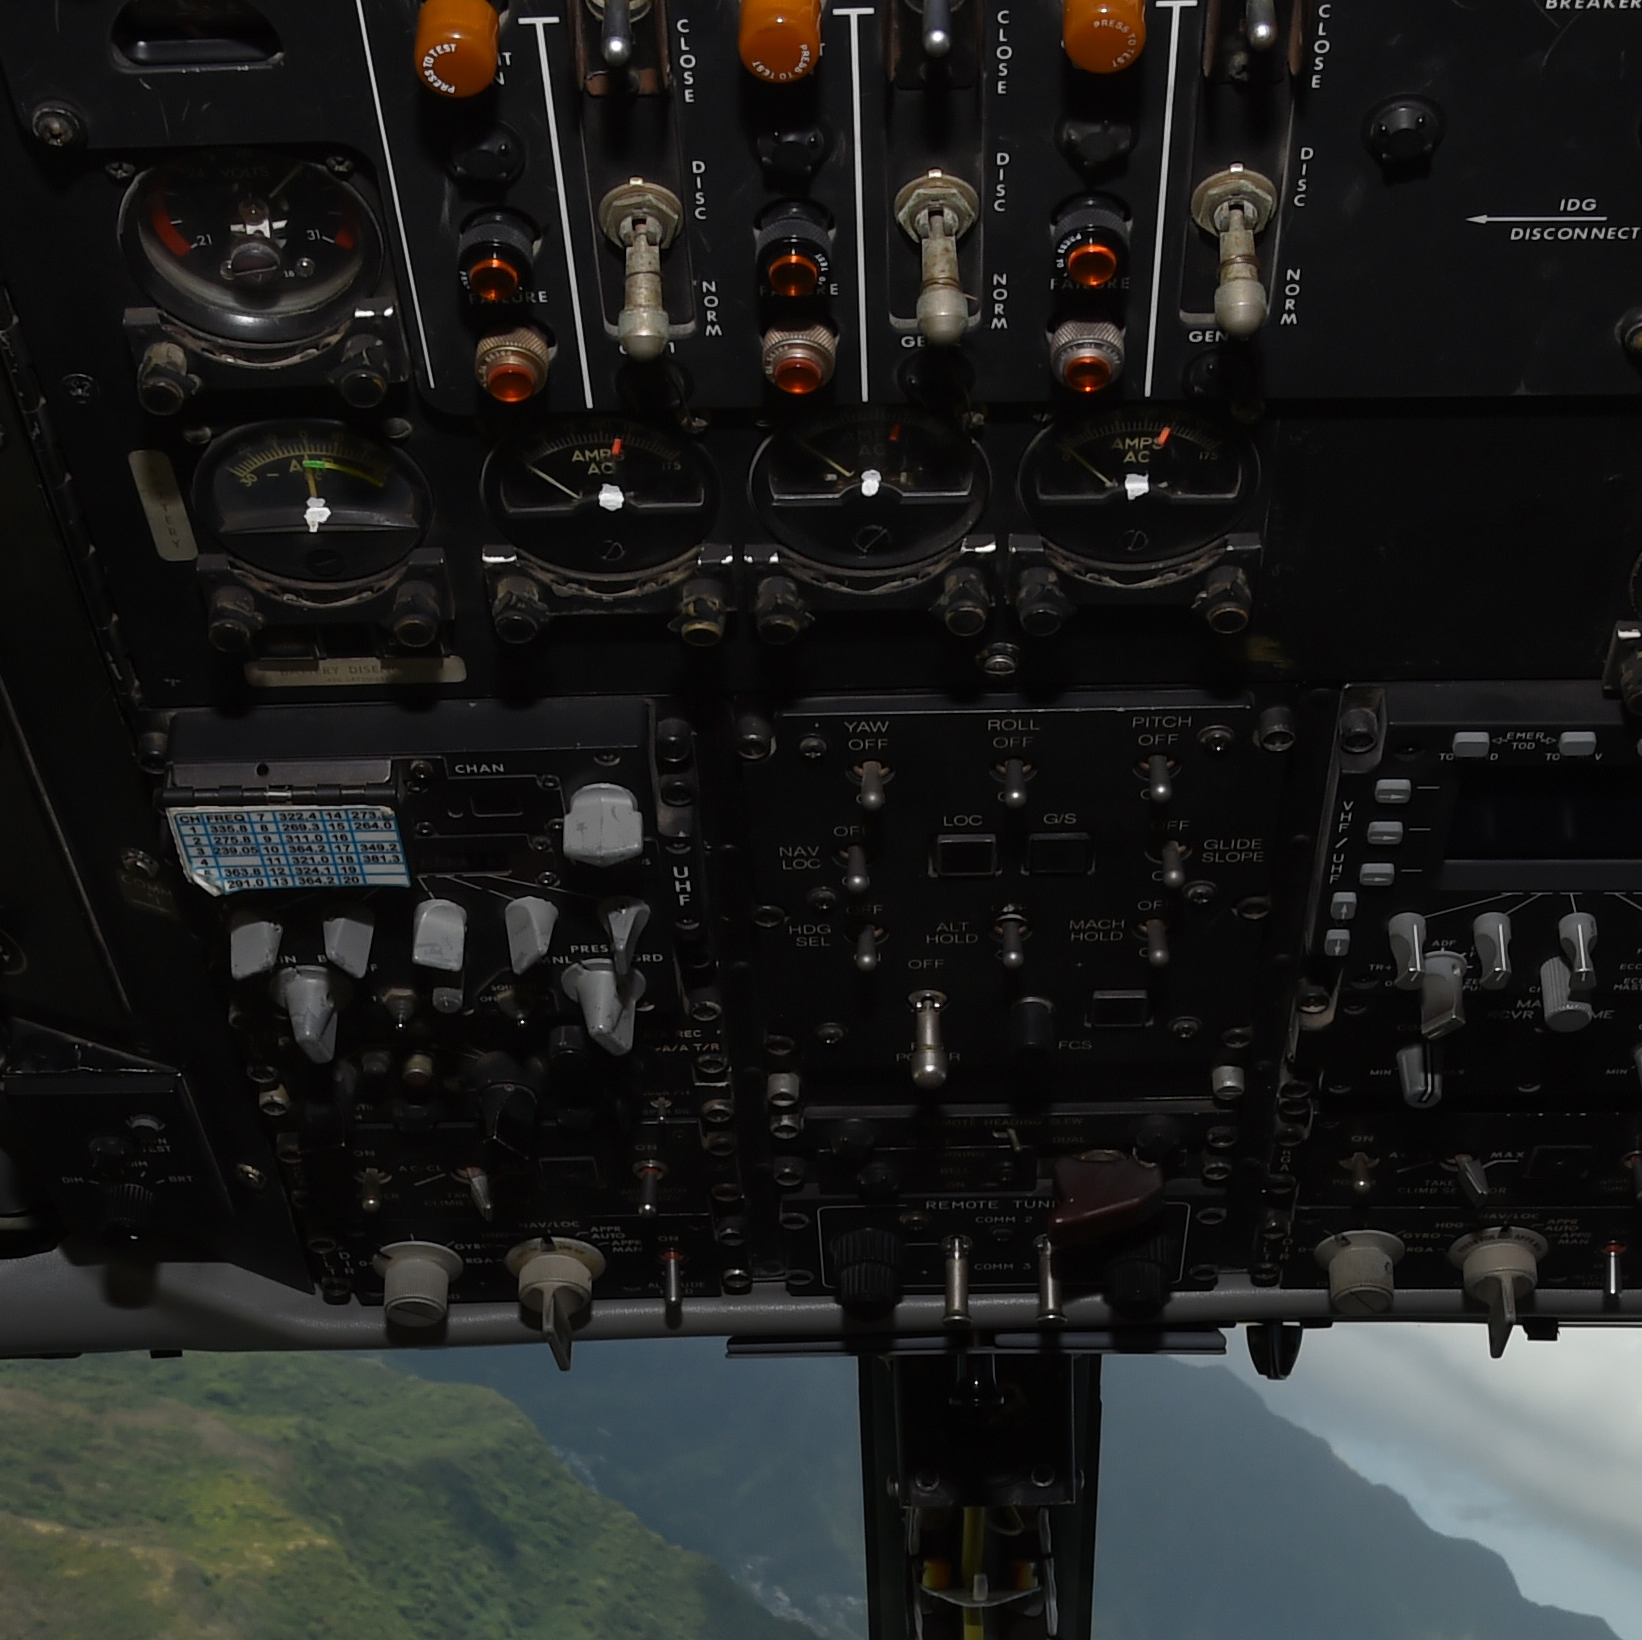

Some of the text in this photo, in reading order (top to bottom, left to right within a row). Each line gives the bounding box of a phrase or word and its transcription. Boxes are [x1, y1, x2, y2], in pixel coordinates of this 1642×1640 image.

[1312, 4, 1331, 88] CLOSE
[997, 10, 1012, 94] CLOSE
[677, 19, 695, 102] CLOSE
[994, 153, 1009, 211] DISC
[1294, 147, 1313, 206] DISC
[692, 161, 706, 219] DISC
[1560, 199, 1596, 211] IDG
[1510, 227, 1640, 240] DISCONNECT
[991, 274, 1007, 329] NORM
[1280, 269, 1300, 324] NORM
[702, 281, 722, 336] NORM
[1189, 331, 1228, 342] GEN
[1113, 437, 1164, 450] AMPS
[1123, 450, 1150, 463] AC
[844, 721, 889, 732] YAW
[988, 719, 1040, 730] ROLL
[1133, 716, 1191, 728] PITCH
[993, 737, 1033, 748] OFF
[1138, 734, 1178, 746] OFF
[1507, 732, 1545, 744] EMER
[848, 738, 888, 750] OFF
[1512, 742, 1535, 750] TOD
[455, 764, 504, 773] CHAN
[179, 813, 245, 823] CH FREQ
[279, 812, 318, 822] 322.4
[944, 815, 982, 826] LOC
[1043, 813, 1076, 824] G/S
[211, 824, 248, 834] 335.8
[282, 823, 319, 832] 269.3
[354, 821, 392, 830] 264.0
[214, 835, 251, 844] 275.8
[285, 833, 322, 842] 311.0
[214, 845, 258, 854] 239.05
[289, 844, 326, 853] 364.2
[359, 843, 396, 852] 349.2
[1204, 839, 1262, 850] GLIDE
[779, 846, 819, 857] NAV
[292, 856, 329, 865] 321.0
[363, 854, 400, 864] 381.3
[1202, 852, 1264, 863] SLOPE
[782, 858, 821, 870] LOC
[673, 866, 691, 906] UHF
[789, 924, 831, 934] HDG
[936, 922, 969, 932] ALT
[1069, 919, 1124, 930] MACH
[796, 936, 830, 947] SEL
[926, 933, 978, 944] HOLD
[1071, 931, 1123, 941] HOLD
[908, 959, 944, 969] OFF
[925, 1200, 999, 1210] REMOTE
[974, 1215, 1016, 1224] COMM
[974, 1263, 1014, 1271] COMM
